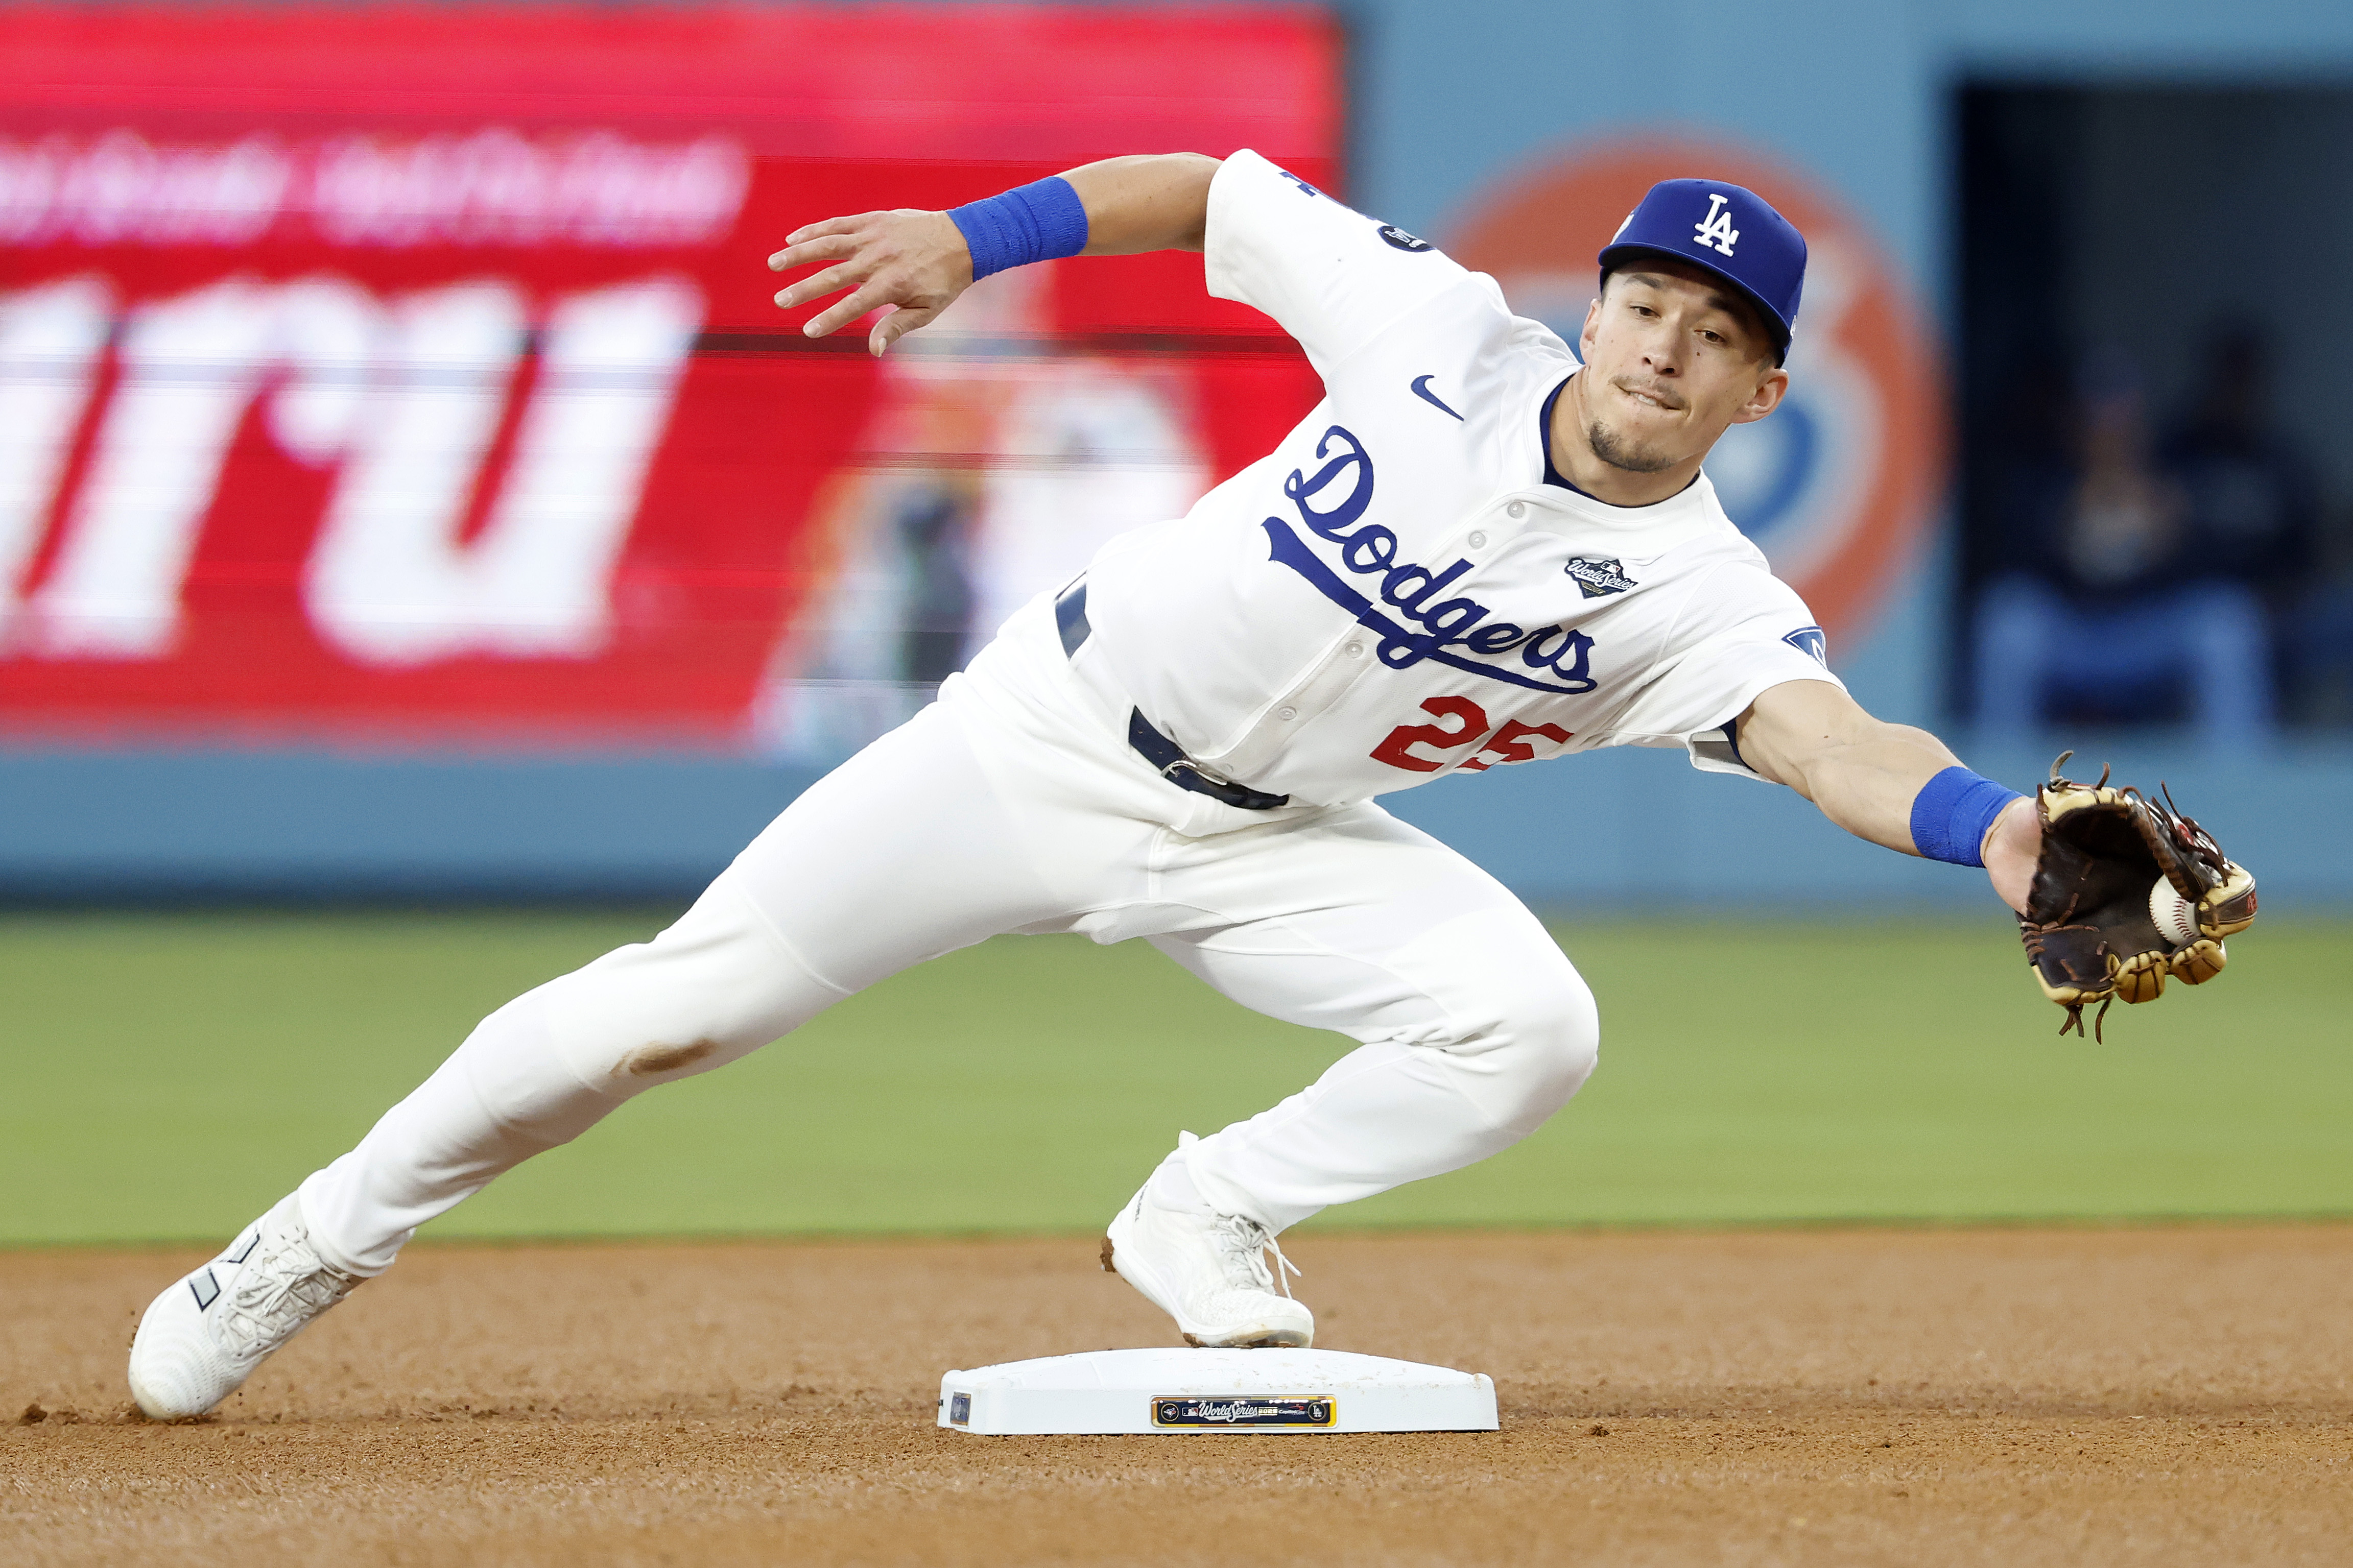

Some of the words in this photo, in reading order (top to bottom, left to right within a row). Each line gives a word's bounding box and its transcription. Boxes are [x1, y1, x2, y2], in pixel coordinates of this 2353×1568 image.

[1693, 194, 1740, 257] LA
[1261, 425, 1598, 693] Dodgers
[1567, 560, 1606, 580] World
[1369, 695, 1574, 771] 25
[1199, 1403, 1231, 1416] World
[1226, 1403, 1258, 1422] Series
